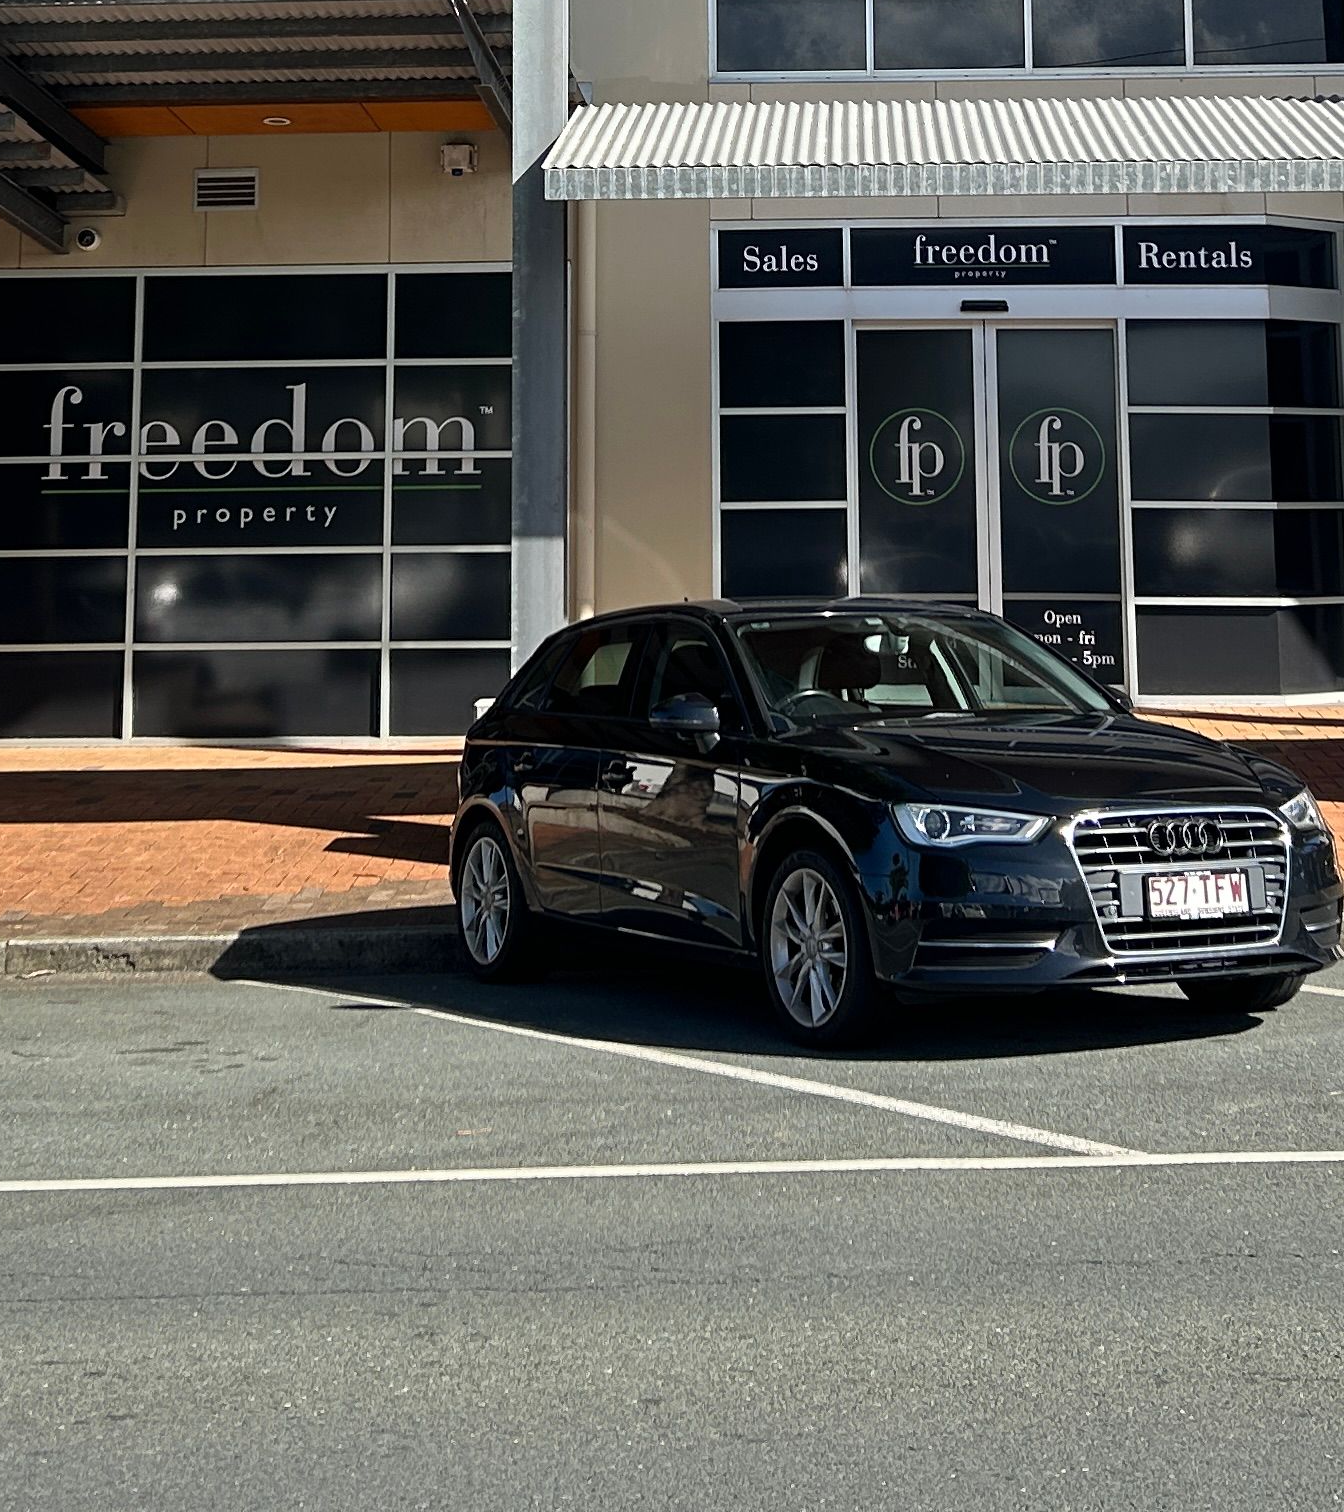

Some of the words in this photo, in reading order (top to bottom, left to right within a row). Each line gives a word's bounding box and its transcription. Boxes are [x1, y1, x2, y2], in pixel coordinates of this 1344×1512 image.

[742, 245, 819, 272] Sales
[913, 234, 1050, 264] freedom
[1137, 241, 1253, 269] Rentals
[954, 269, 1007, 279] property
[41, 382, 483, 481] freedom
[172, 503, 338, 530] property
[1044, 610, 1082, 628] Open
[1078, 630, 1096, 645] fri
[1082, 650, 1116, 668] 5pm
